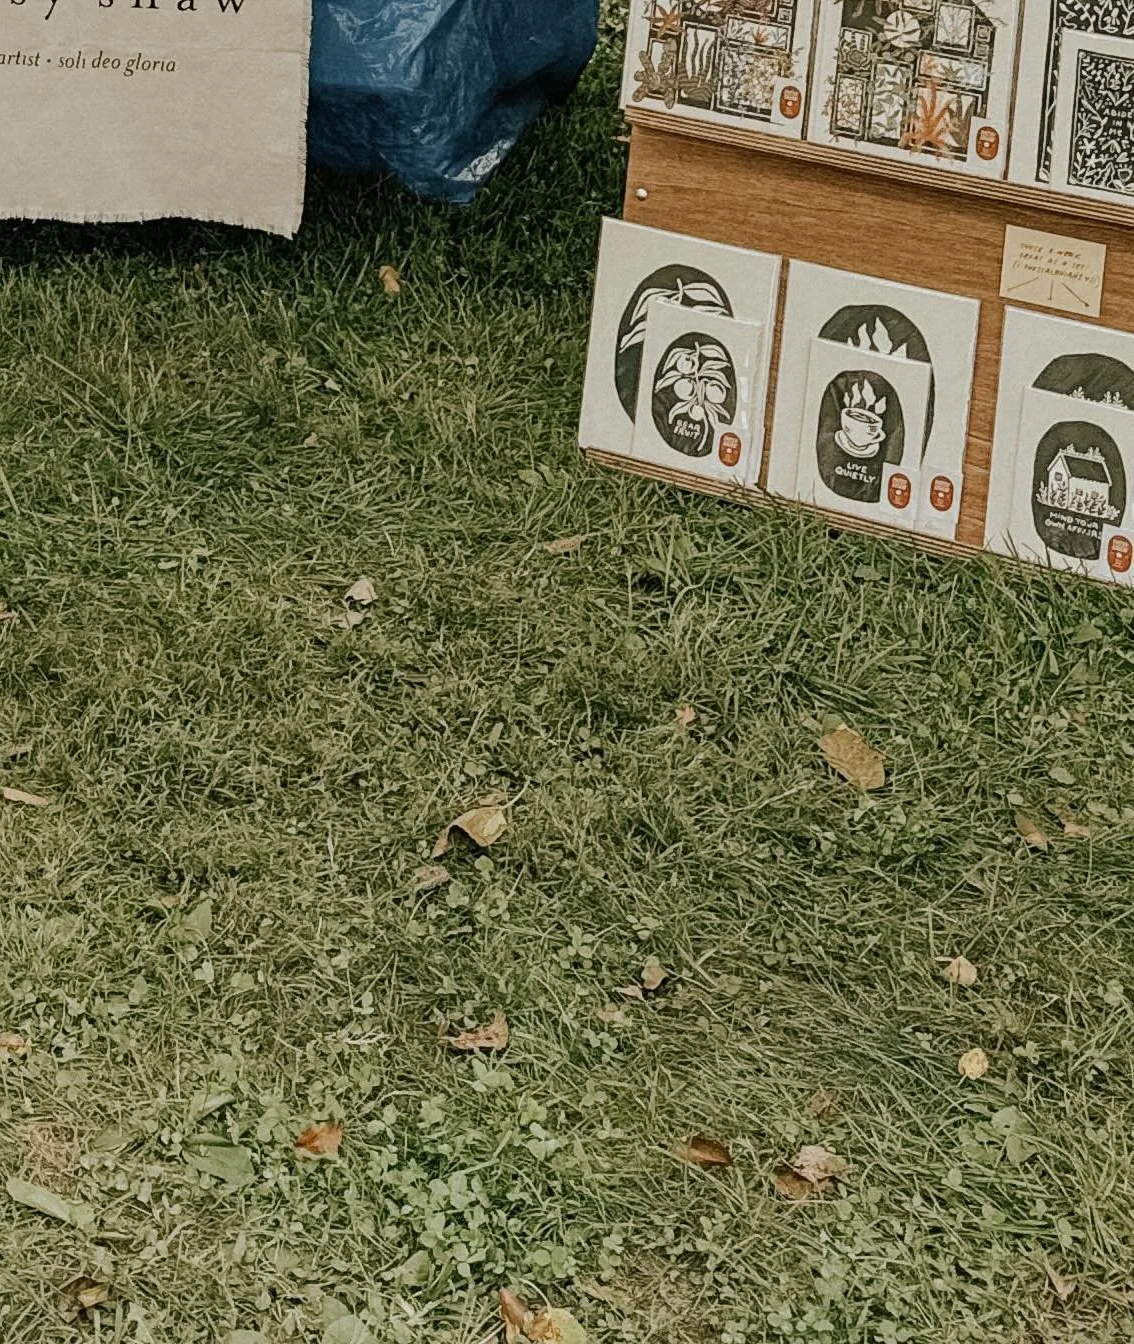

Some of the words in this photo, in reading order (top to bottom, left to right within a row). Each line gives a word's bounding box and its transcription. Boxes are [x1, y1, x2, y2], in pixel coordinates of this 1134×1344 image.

[58, 50, 87, 69] soli
[91, 50, 121, 70] deo
[123, 52, 176, 77] gloria
[1103, 108, 1133, 119] ABIDE
[1112, 119, 1123, 127] IN
[1109, 127, 1123, 137] ME
[673, 425, 700, 440] FRUIT
[676, 419, 701, 433] BEAR
[846, 462, 868, 473] LIVE
[834, 466, 876, 483] QUIETLY
[1044, 518, 1066, 530] OWN
[1049, 511, 1074, 523] MIND
[1074, 517, 1099, 530] YOUR
